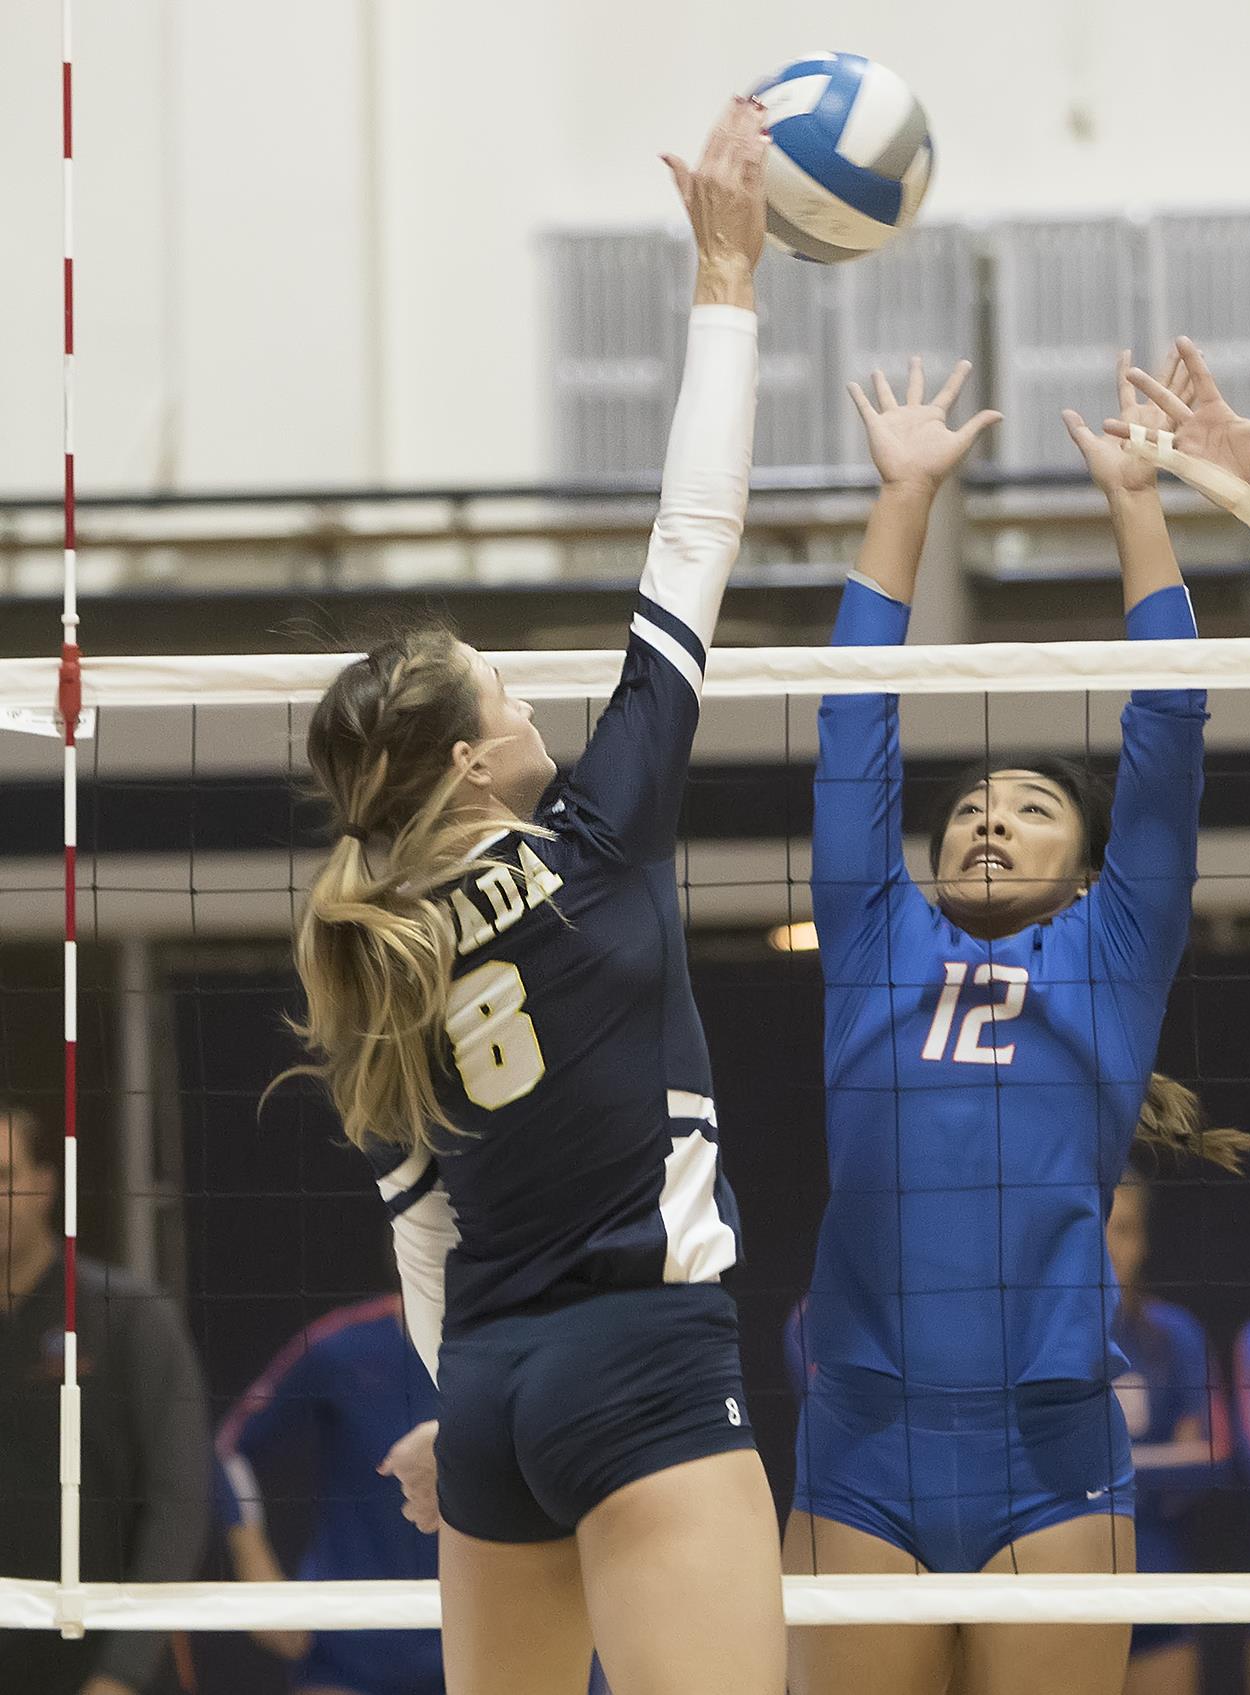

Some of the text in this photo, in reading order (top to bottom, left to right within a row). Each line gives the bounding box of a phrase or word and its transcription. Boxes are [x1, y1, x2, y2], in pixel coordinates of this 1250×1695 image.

[451, 840, 564, 956] ADA
[446, 960, 546, 1112] 8
[921, 960, 1029, 1066] 12
[724, 1396, 741, 1427] 8
